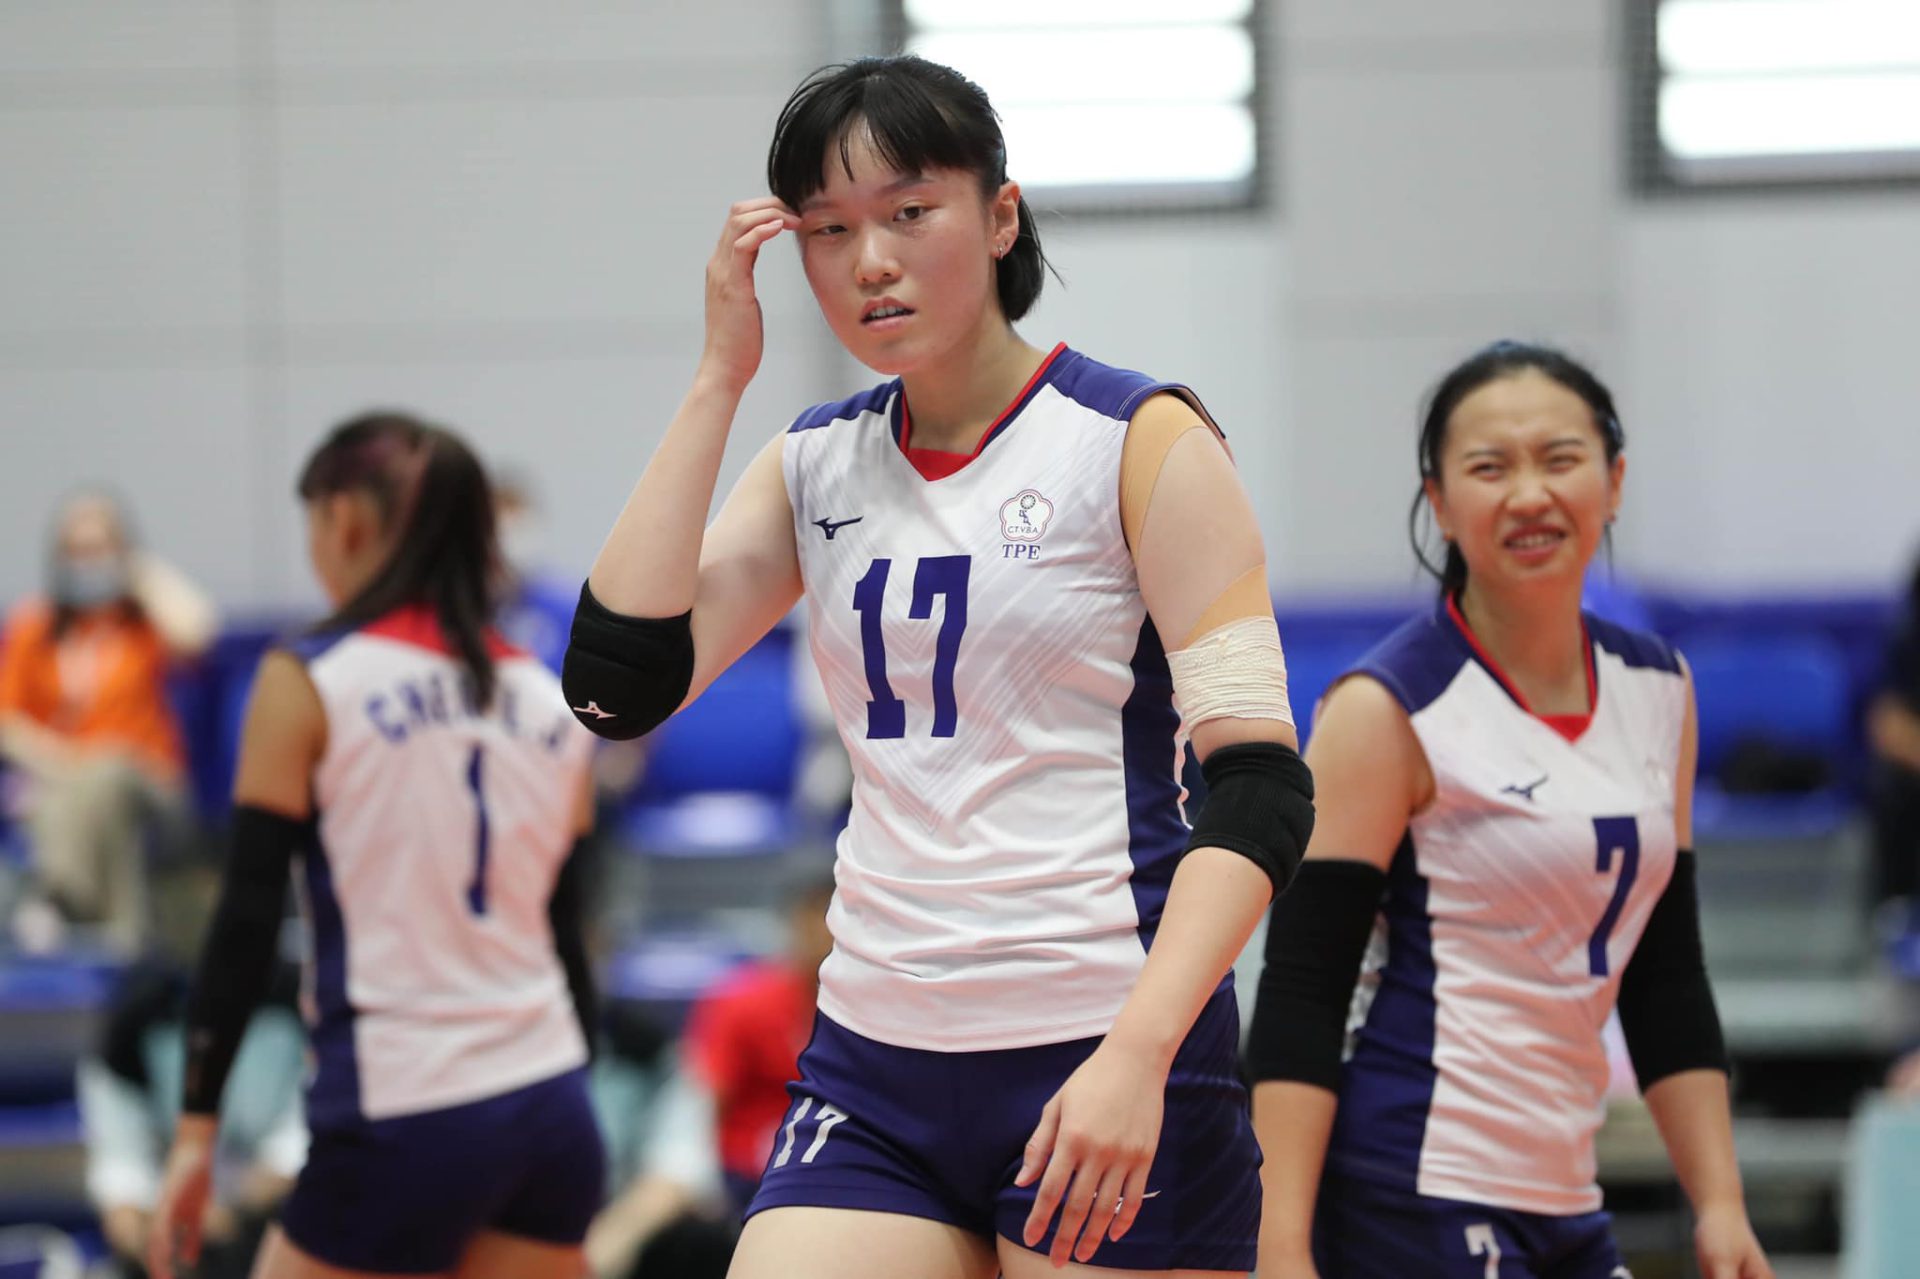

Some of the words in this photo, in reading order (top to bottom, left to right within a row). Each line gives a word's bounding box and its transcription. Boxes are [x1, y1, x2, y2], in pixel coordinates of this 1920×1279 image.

[1002, 544, 1041, 560] TPE
[852, 555, 972, 739] 17
[466, 740, 489, 917] 1
[1588, 815, 1640, 977] 7
[773, 1097, 849, 1169] 17
